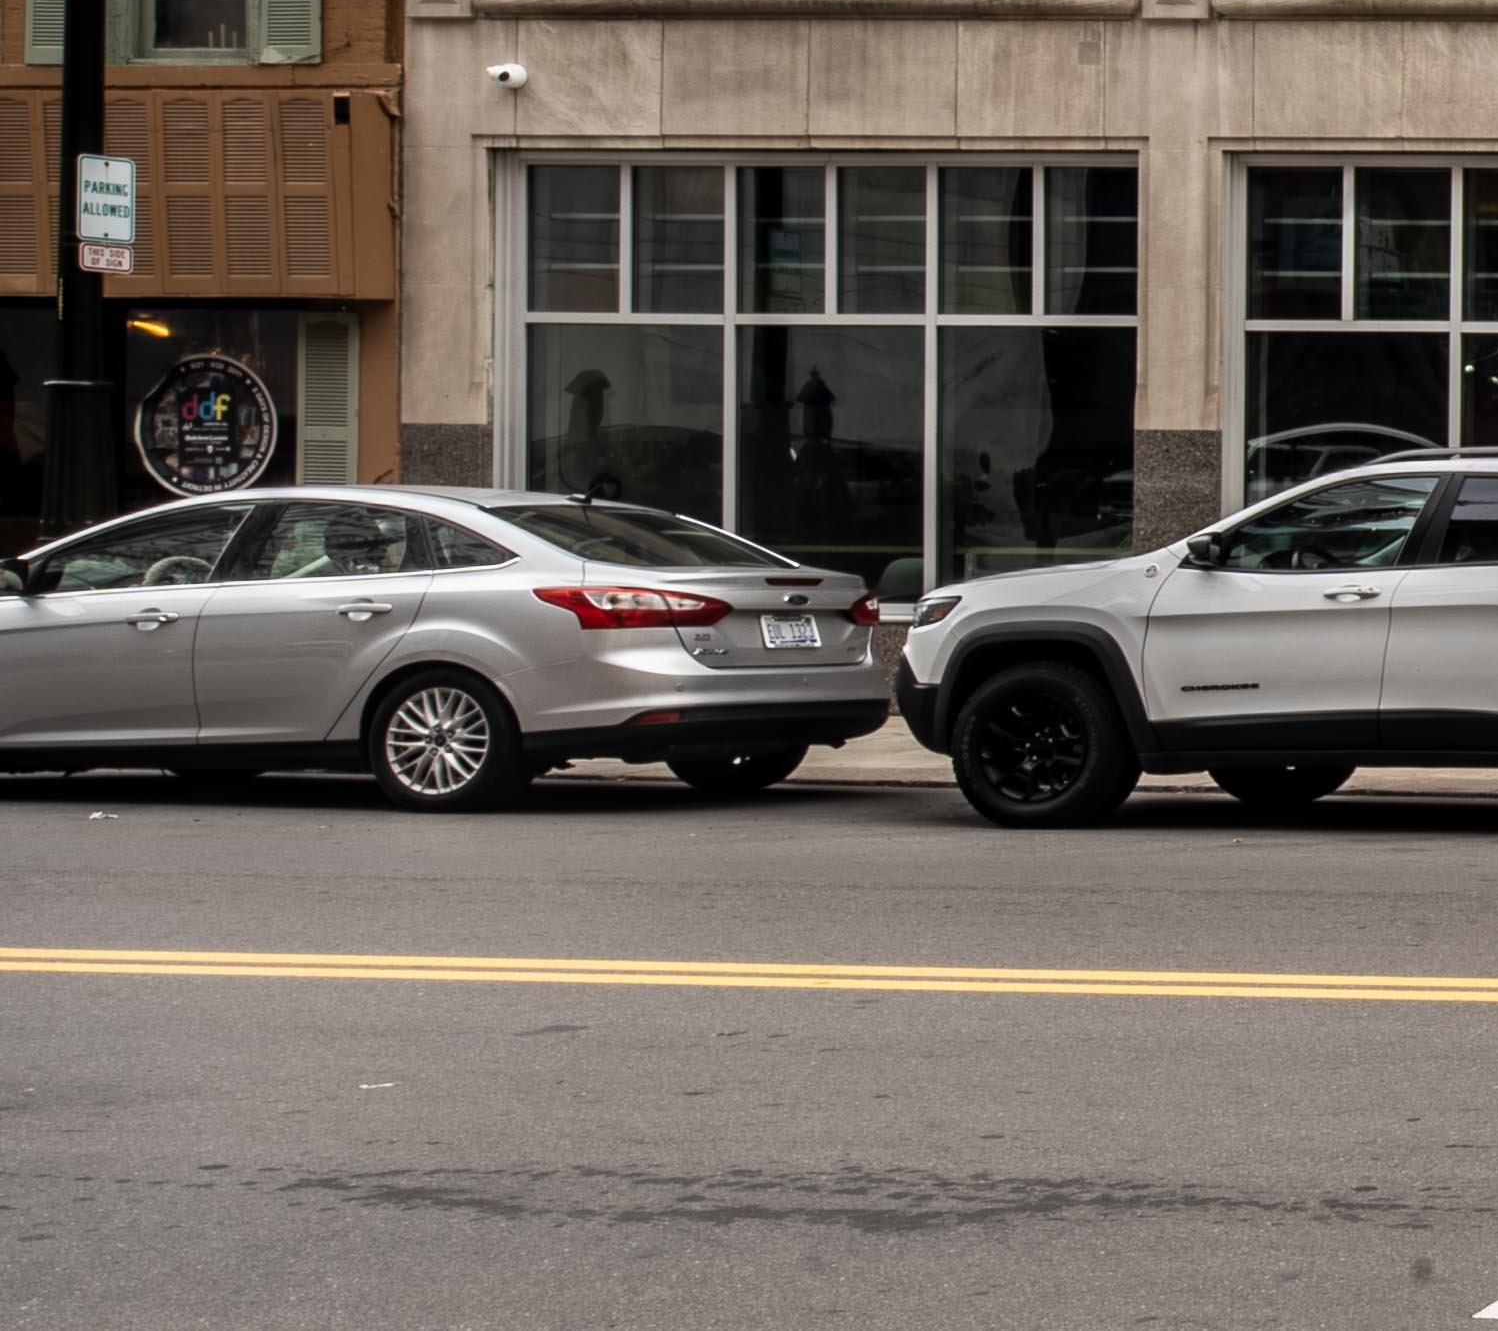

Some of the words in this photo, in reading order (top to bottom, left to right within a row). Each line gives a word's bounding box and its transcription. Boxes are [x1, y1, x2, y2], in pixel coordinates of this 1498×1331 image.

[84, 180, 129, 197] PARKING
[82, 201, 130, 218] ALLOWED
[181, 391, 231, 420] ddf
